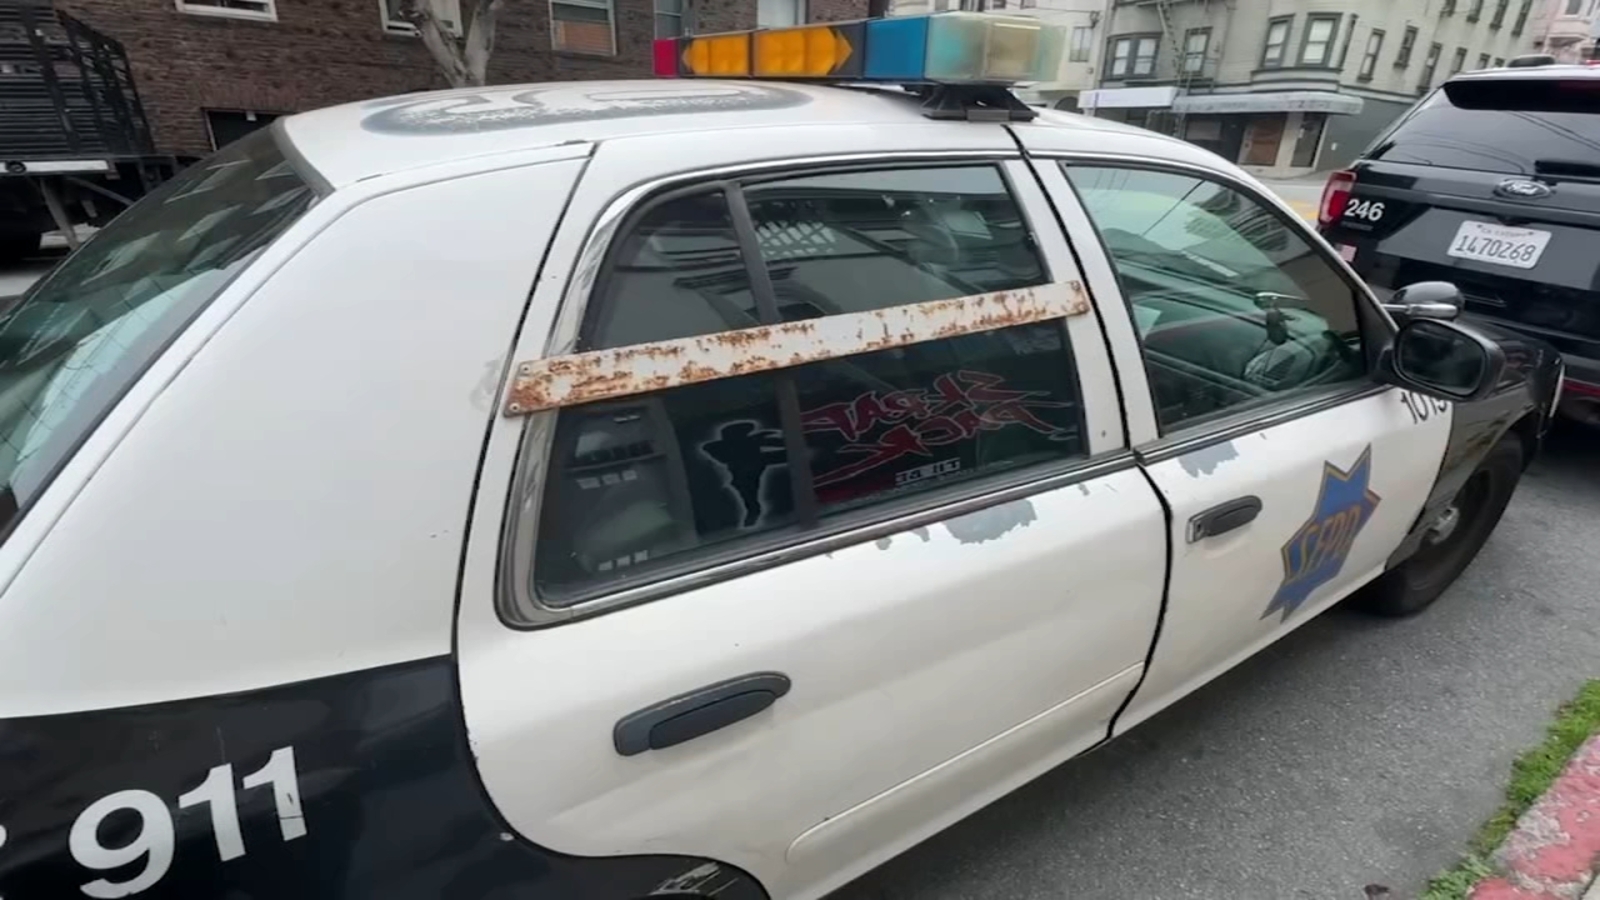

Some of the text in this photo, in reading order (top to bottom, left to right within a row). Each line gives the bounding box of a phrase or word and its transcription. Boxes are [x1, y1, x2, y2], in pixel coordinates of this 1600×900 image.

[1344, 198, 1385, 221] 246
[1455, 235, 1536, 262] 1470268
[69, 746, 307, 899] 911
